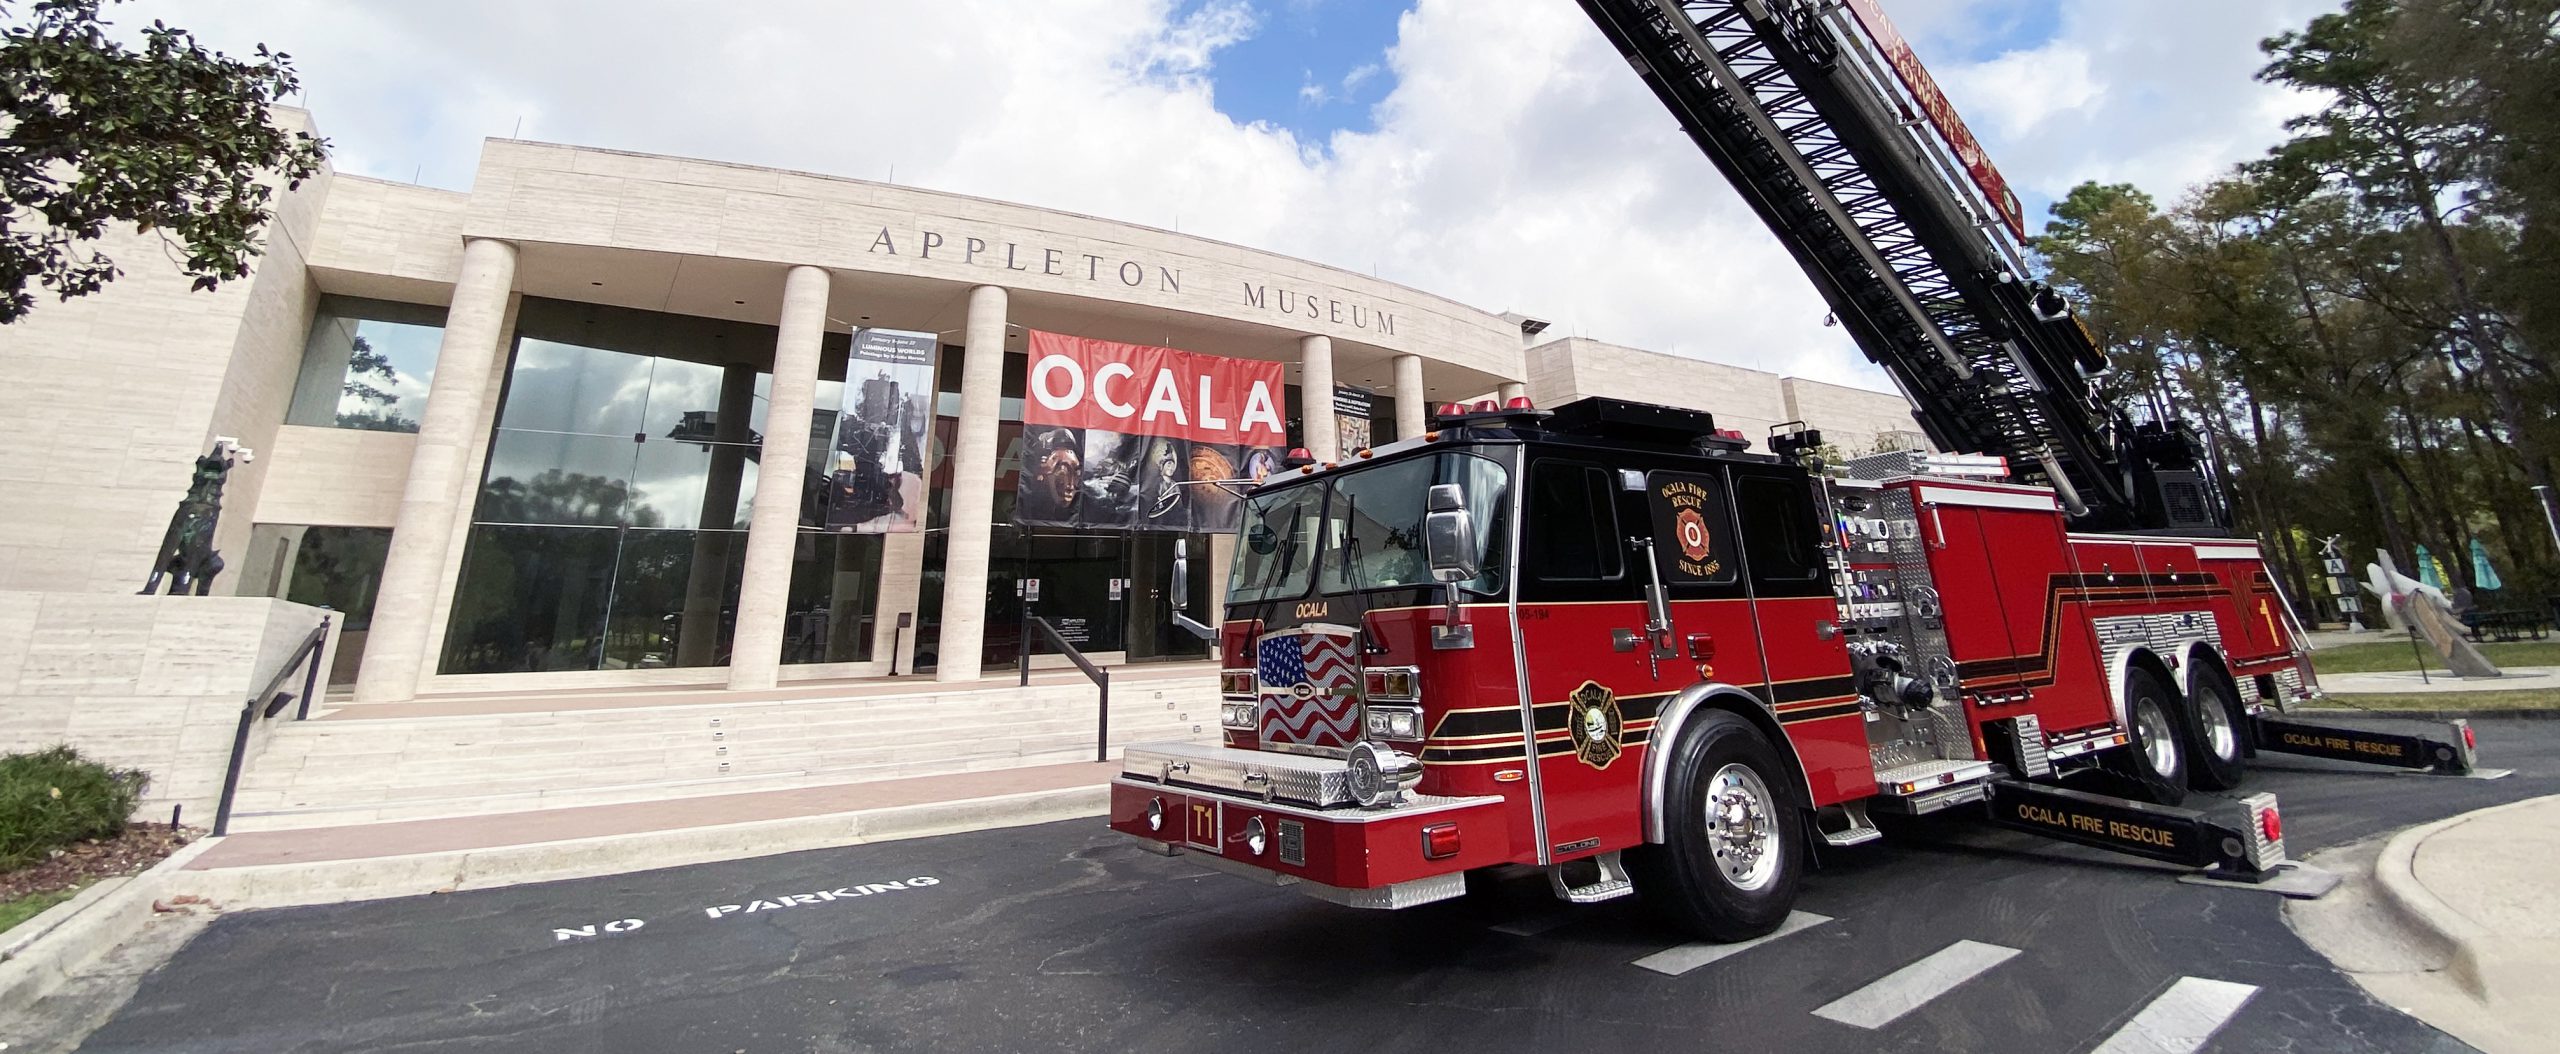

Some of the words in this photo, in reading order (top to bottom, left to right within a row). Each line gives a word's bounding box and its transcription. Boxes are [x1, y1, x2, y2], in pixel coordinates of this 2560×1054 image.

[1862, 0, 1904, 54] CALA
[1890, 43, 1954, 143] TOWER
[868, 225, 1182, 294] APPLETON
[1243, 281, 1395, 336] MUSEUM
[862, 343, 896, 353] LUMINOUS
[1031, 354, 1283, 433] OCALA
[1661, 482, 1686, 498] OCALA
[1688, 483, 1708, 501] FIRE
[1672, 494, 1702, 509] RESCUE
[1679, 560, 1703, 576] SINCE
[2331, 560, 2342, 572] A
[1296, 601, 1328, 618] OCALA
[2260, 598, 2280, 647] 1
[1581, 689, 1602, 704] OCALA
[1588, 750, 1615, 762] RESCUE
[2283, 733, 2322, 746] OCALA
[2325, 737, 2351, 750] FIRE
[2354, 741, 2403, 757] RESCUE
[1193, 804, 1213, 839] T1
[2018, 804, 2067, 827] OCALA
[2071, 814, 2105, 834] FIRE
[2109, 821, 2175, 847] RESCUE
[552, 918, 645, 941] NO
[704, 875, 942, 919] PARKING
